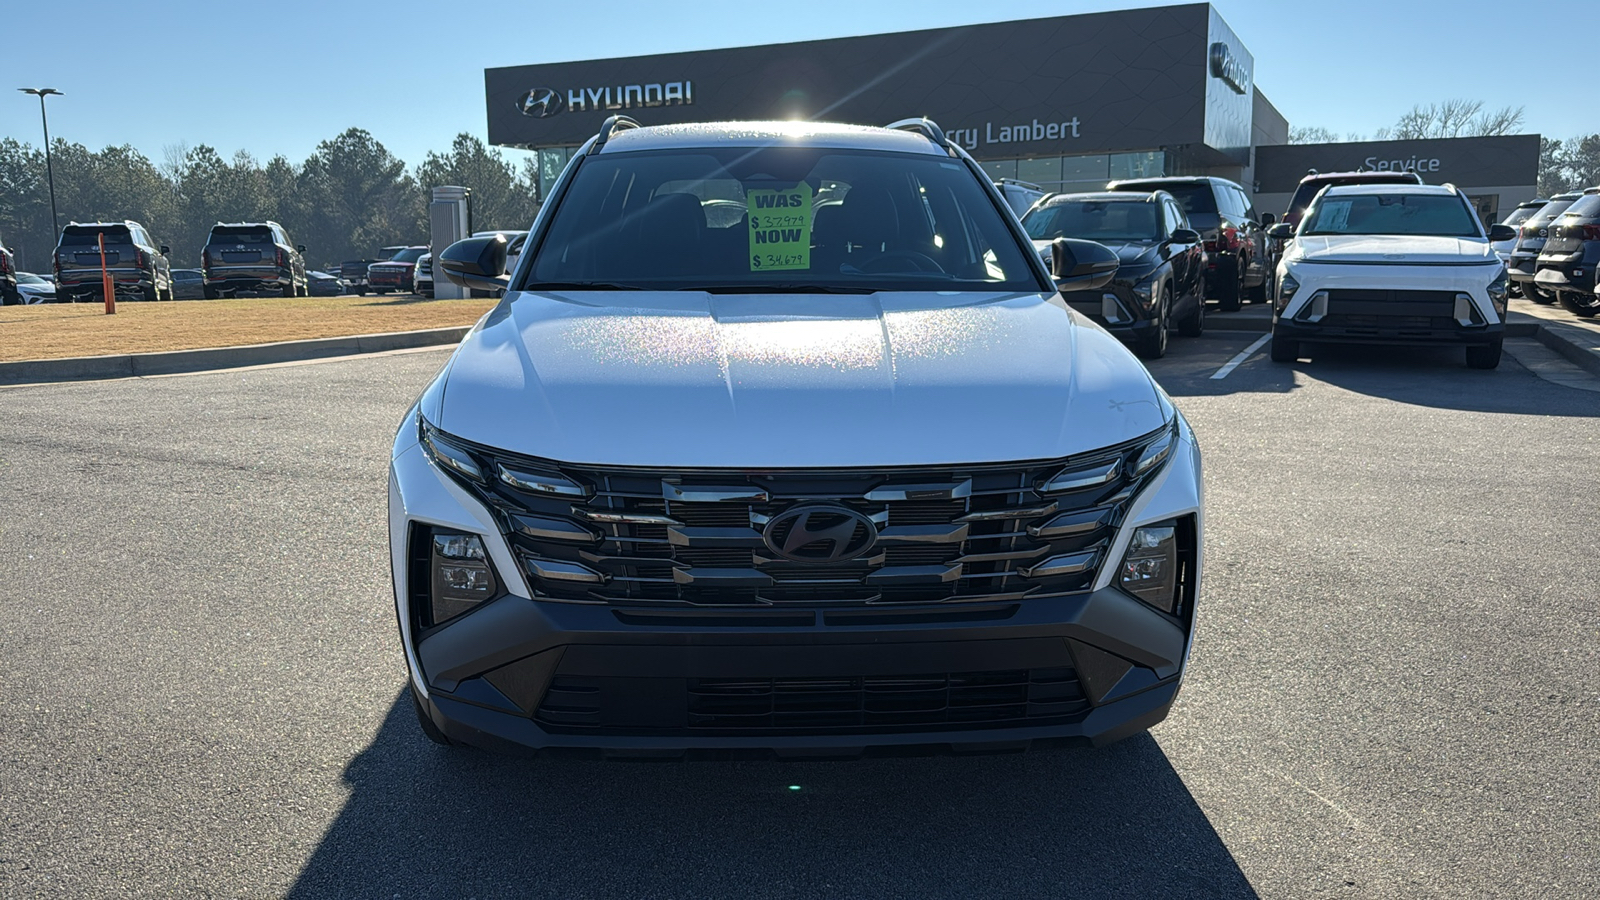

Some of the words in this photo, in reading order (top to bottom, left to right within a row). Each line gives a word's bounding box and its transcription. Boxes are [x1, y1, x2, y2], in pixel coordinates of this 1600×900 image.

[567, 81, 692, 111] HYUNDAI
[986, 117, 1080, 143] Lambert
[1365, 155, 1440, 172] Service
[755, 194, 802, 208] WAS
[755, 229, 802, 243] NOW
